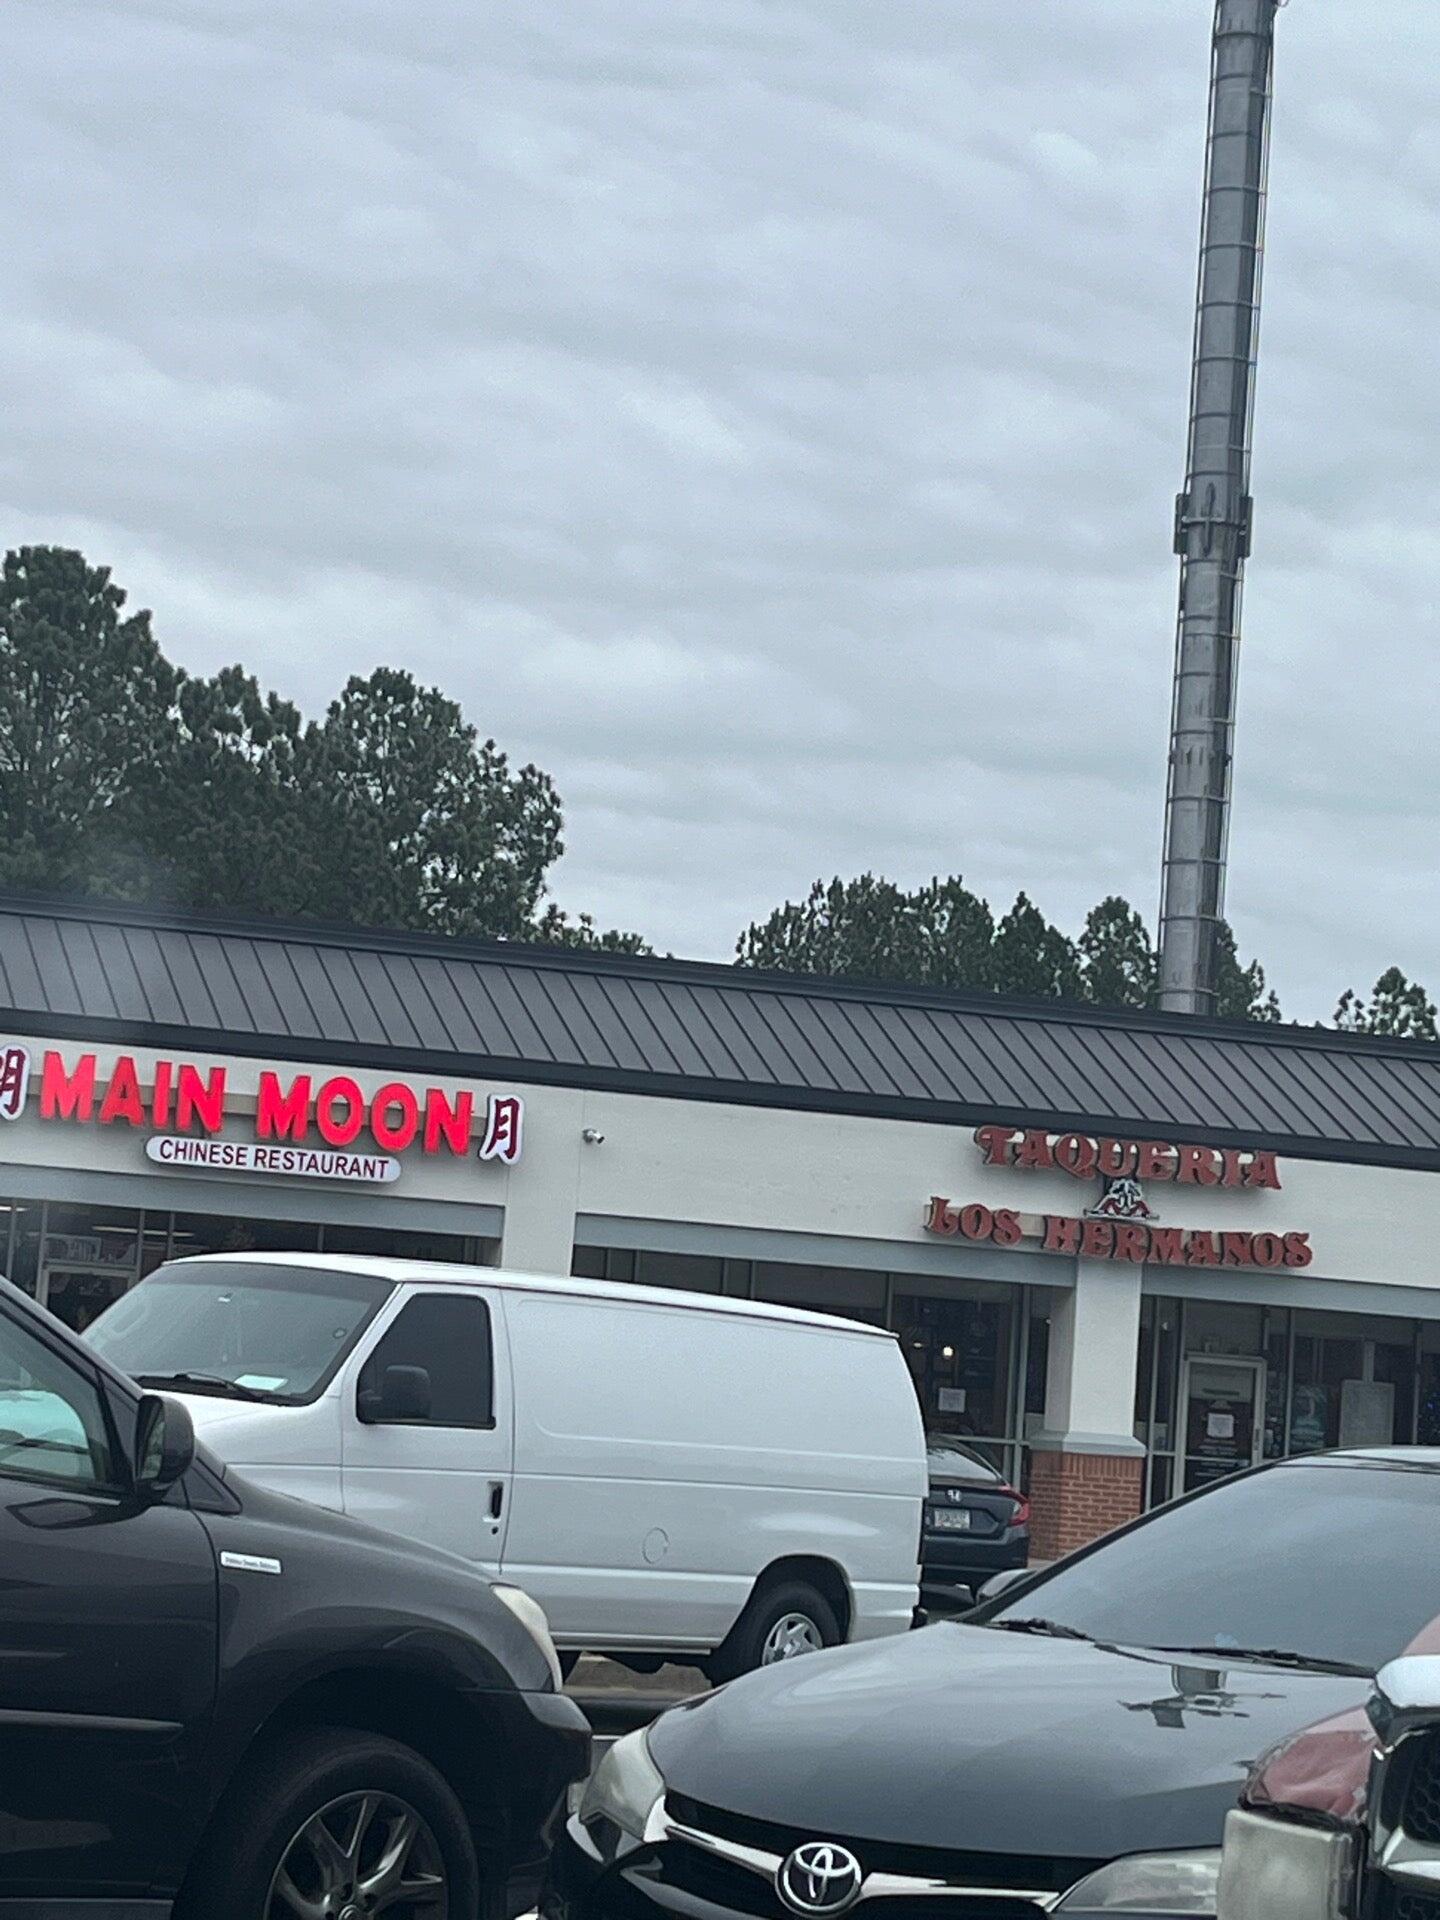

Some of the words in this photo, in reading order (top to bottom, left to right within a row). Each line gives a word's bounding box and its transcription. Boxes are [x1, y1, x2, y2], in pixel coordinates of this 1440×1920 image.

[40, 1050, 227, 1133] MAIN
[256, 1071, 474, 1157] MOON
[487, 1097, 519, 1160] 月
[159, 1139, 248, 1166] CHINESE
[254, 1148, 389, 1179] RESTAURANT
[974, 1125, 1282, 1190] TAQUERIA
[925, 1197, 1023, 1246] LOS
[1042, 1214, 1313, 1268] HERMANOS
